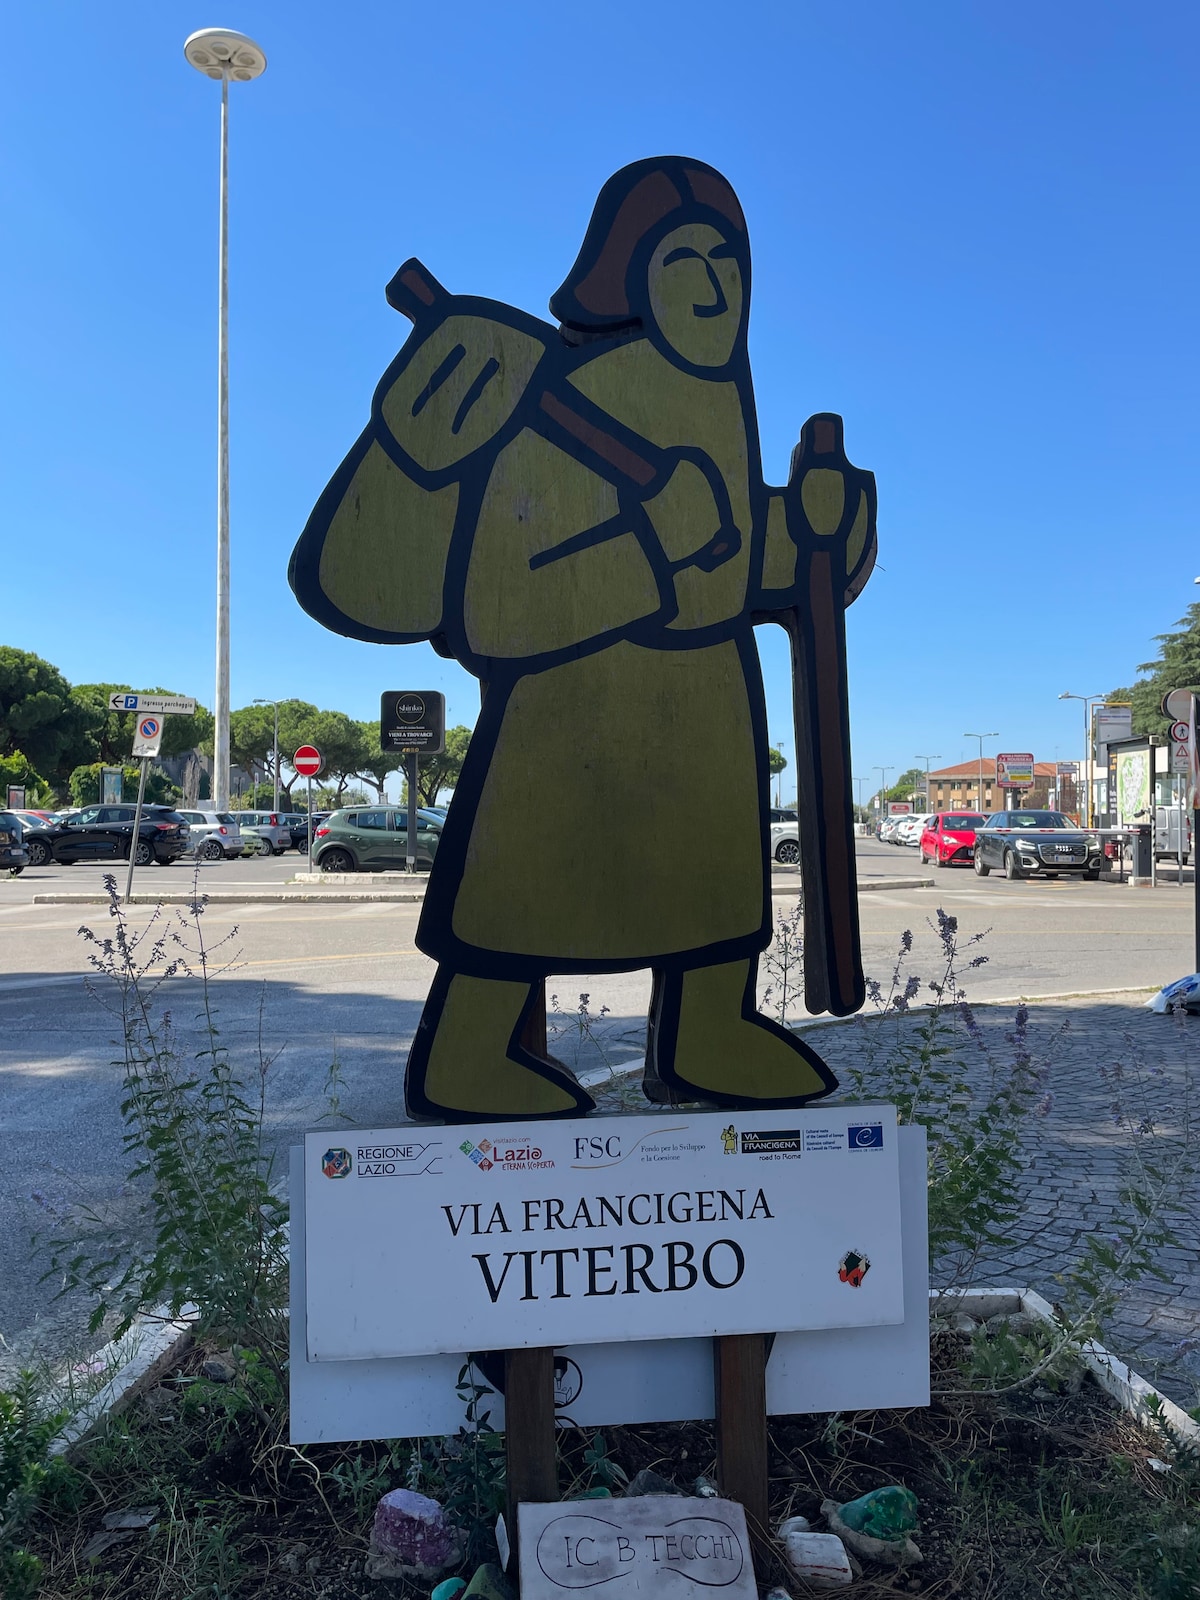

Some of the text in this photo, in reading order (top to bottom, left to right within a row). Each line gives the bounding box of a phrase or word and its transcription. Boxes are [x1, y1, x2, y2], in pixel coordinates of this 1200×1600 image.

[127, 698, 193, 710] P ingresso parcheggio
[492, 1137, 532, 1145] visitlazio.com
[743, 1133, 760, 1141] VIA
[572, 1136, 622, 1160] FSC
[640, 1143, 707, 1154] Fondo per lo Sviluppo
[744, 1141, 798, 1151] FRANCIGENA
[356, 1146, 414, 1161] REGIONE
[492, 1145, 543, 1163] Lazio
[653, 1154, 681, 1162] Coesione
[782, 1153, 802, 1161] Rome
[356, 1163, 396, 1177] LAZIO
[502, 1160, 556, 1171] ETERNA SCOPERTA
[441, 1187, 776, 1237] VIA FRANCIGENA
[471, 1238, 746, 1303] VITERBO
[645, 1535, 735, 1561] TECCHI
